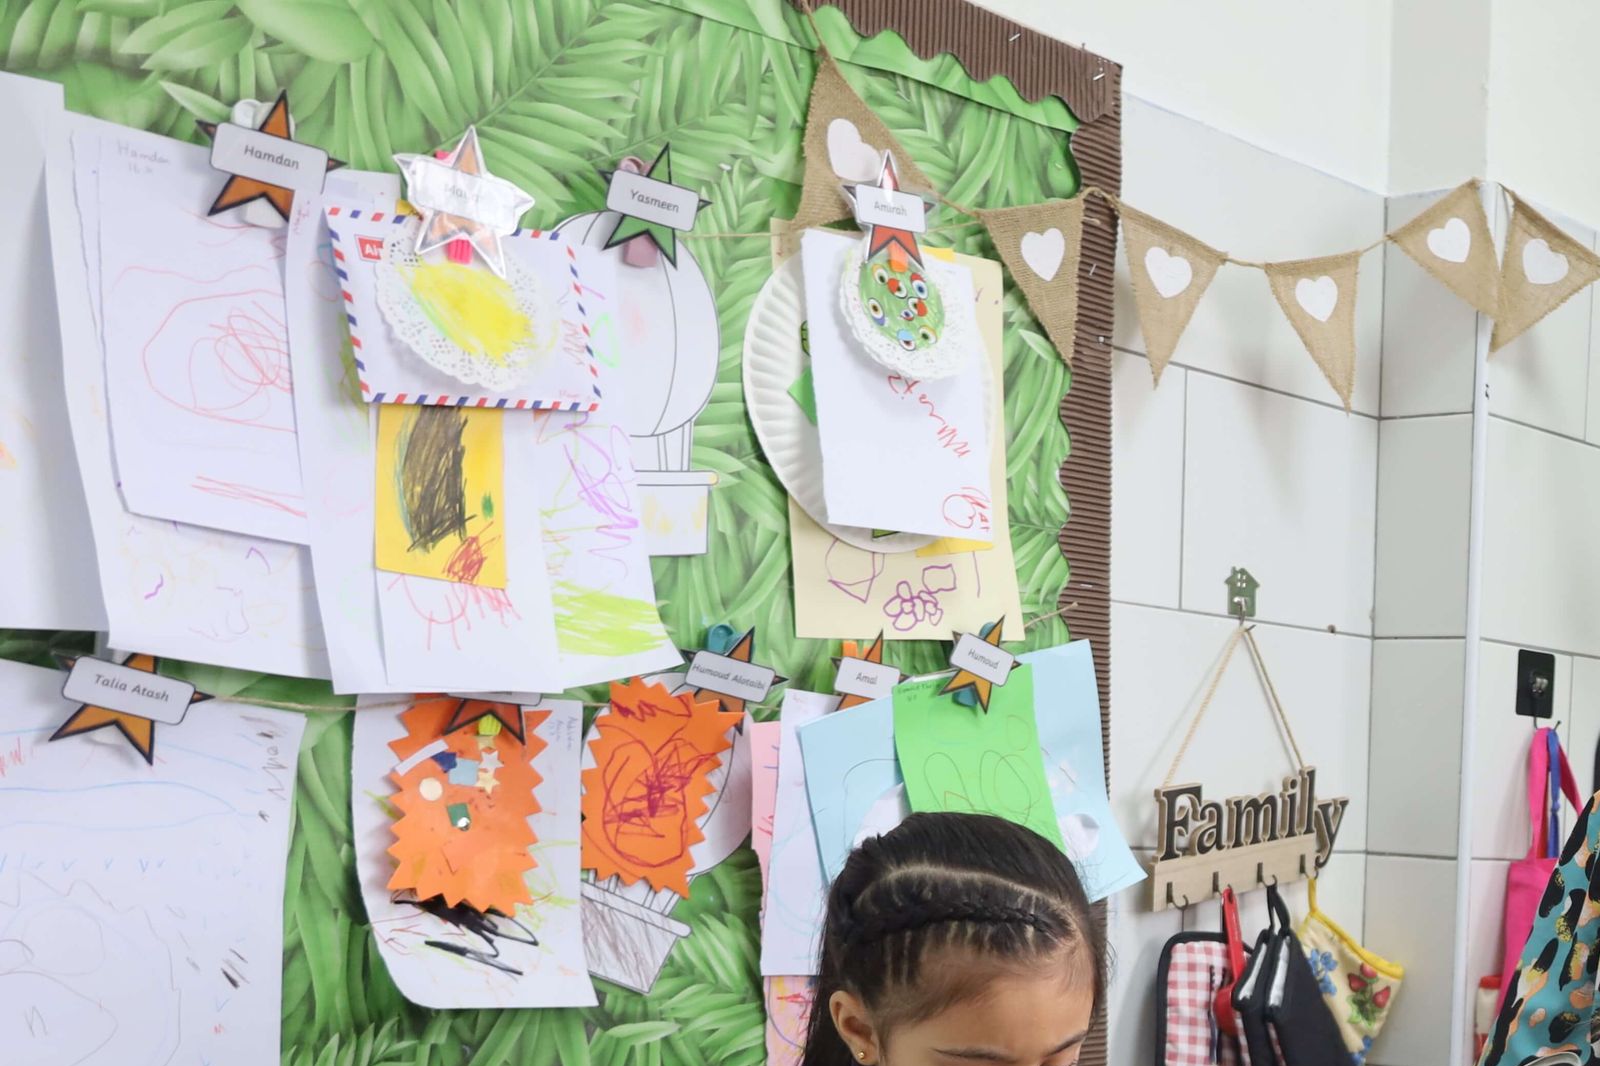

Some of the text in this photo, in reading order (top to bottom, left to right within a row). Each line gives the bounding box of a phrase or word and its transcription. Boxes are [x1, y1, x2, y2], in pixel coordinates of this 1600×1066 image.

[244, 144, 300, 171] Hamdan
[630, 188, 680, 214] Yasmeen
[967, 647, 1000, 670] Humoud
[691, 663, 731, 683] Humoud
[855, 672, 878, 685] Amal
[95, 673, 170, 702] Talia Atash
[1156, 767, 1350, 869] Family
